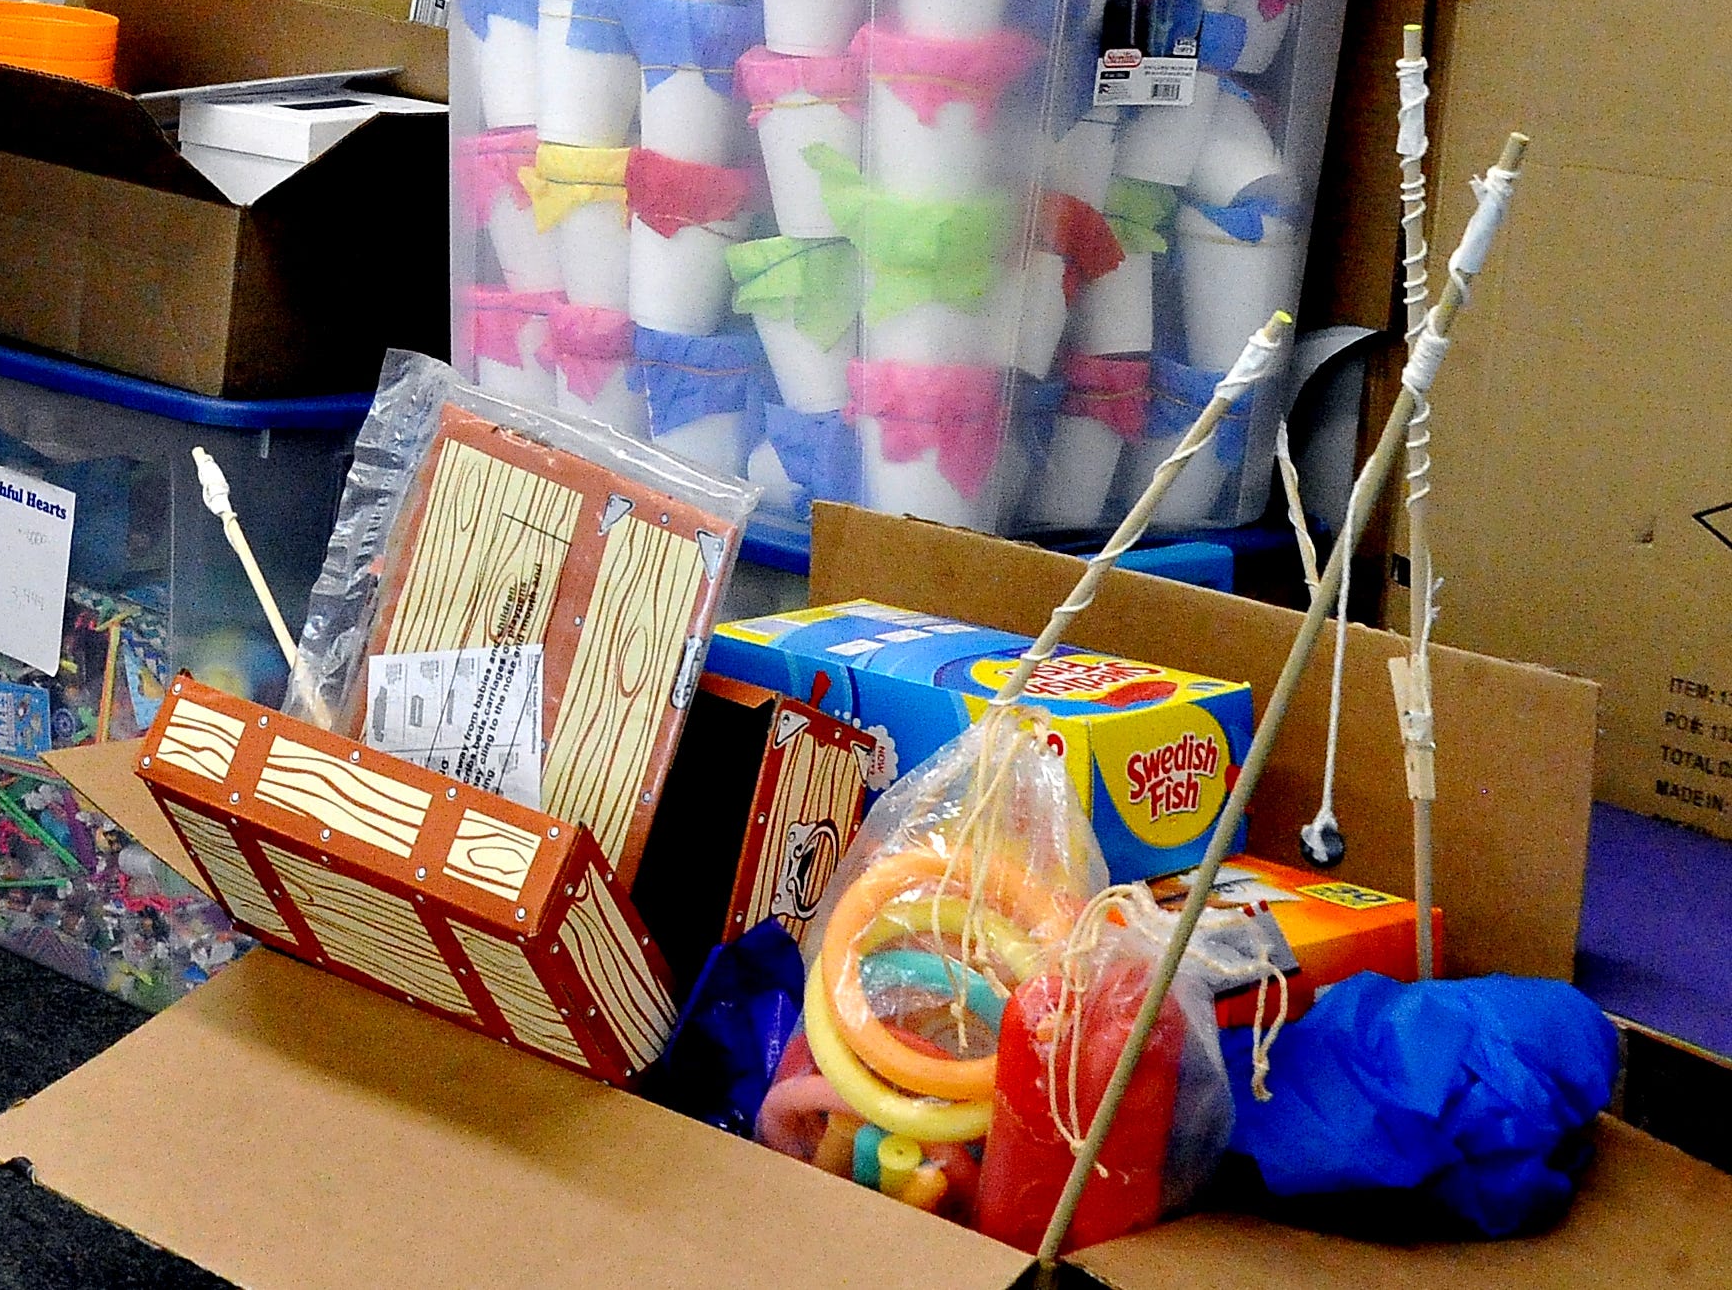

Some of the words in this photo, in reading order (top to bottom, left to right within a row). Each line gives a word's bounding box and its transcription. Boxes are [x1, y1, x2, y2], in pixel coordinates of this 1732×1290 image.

[25, 492, 67, 520] Hearts
[480, 734, 495, 765] cling
[489, 717, 499, 731] to
[494, 695, 506, 715] the
[503, 660, 517, 693] nose
[514, 634, 525, 658] and
[520, 591, 537, 631] mouth
[533, 563, 543, 588] and
[503, 641, 511, 654] or
[1024, 661, 1162, 696] Swedish
[455, 744, 469, 779] away
[464, 711, 478, 741] from
[473, 667, 492, 709] babies
[489, 639, 500, 664] and
[877, 745, 886, 774] NOW
[1127, 734, 1218, 800] Swedish
[1661, 744, 1714, 775] TOTAL
[1149, 773, 1199, 820] Fish
